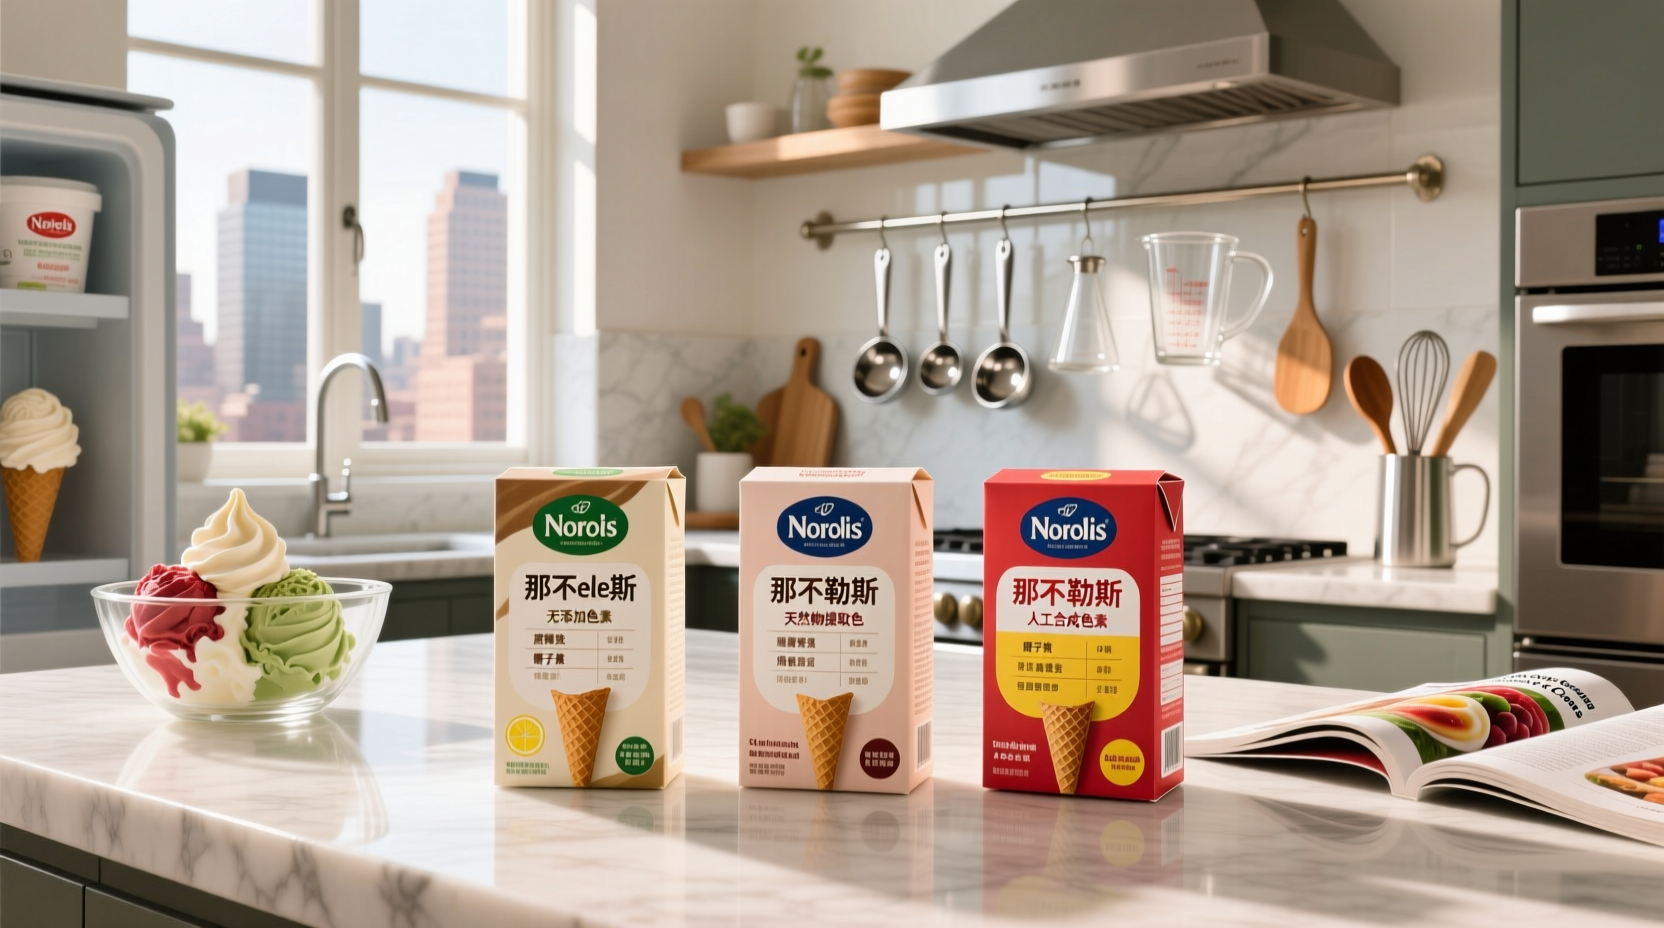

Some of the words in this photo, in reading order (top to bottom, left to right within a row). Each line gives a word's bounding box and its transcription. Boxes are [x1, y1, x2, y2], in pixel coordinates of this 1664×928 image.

[788, 514, 863, 540] Norolis
[1030, 516, 1108, 541] Norolis
[524, 573, 637, 602] 那不ele斯
[770, 576, 879, 606] 那不勒斯
[1012, 577, 1123, 608] 那不勒斯
